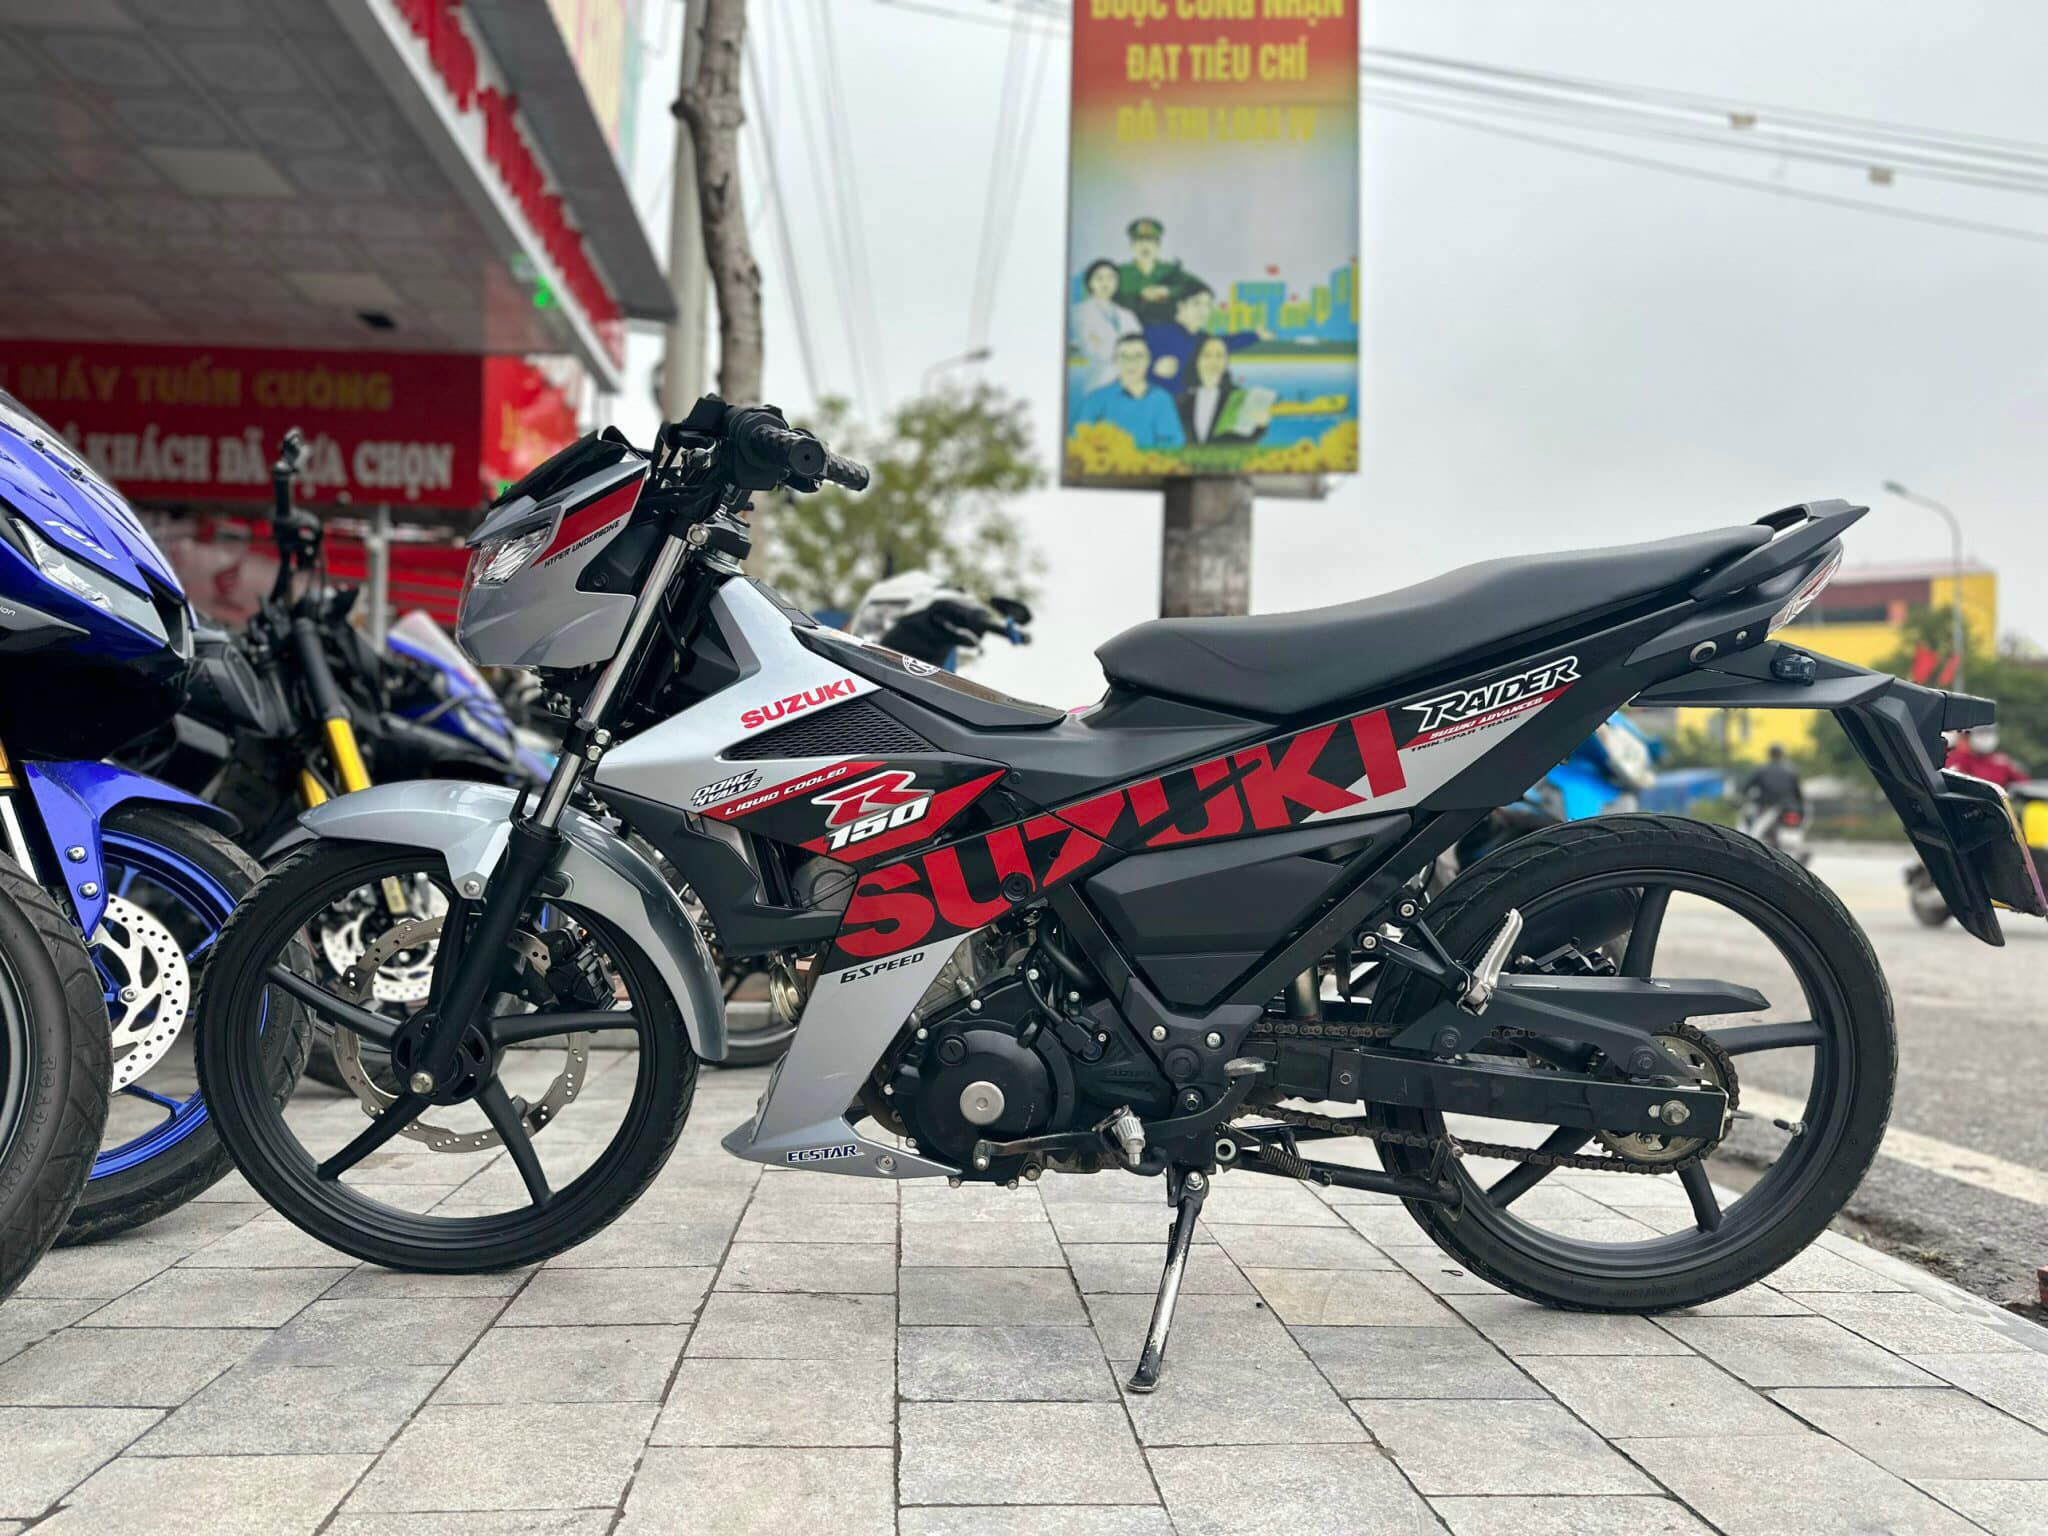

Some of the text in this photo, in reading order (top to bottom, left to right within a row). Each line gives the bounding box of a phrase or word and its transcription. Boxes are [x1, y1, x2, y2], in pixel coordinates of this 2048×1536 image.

[1126, 35, 1308, 90] ĐẠT TIÊU CHÍ
[354, 439, 455, 501] CHỌN
[544, 519, 621, 569] HYPER UNDERBONE
[740, 678, 857, 729] SUZUKI
[1402, 656, 1582, 733] RAIDER
[1430, 720, 1477, 740] SUZUKI
[692, 769, 757, 800] DOHC
[725, 766, 847, 816] LIQUID COOLED
[828, 796, 931, 852] 150
[835, 708, 1406, 957] SUZUKI
[786, 1144, 866, 1162] ECSTAR
